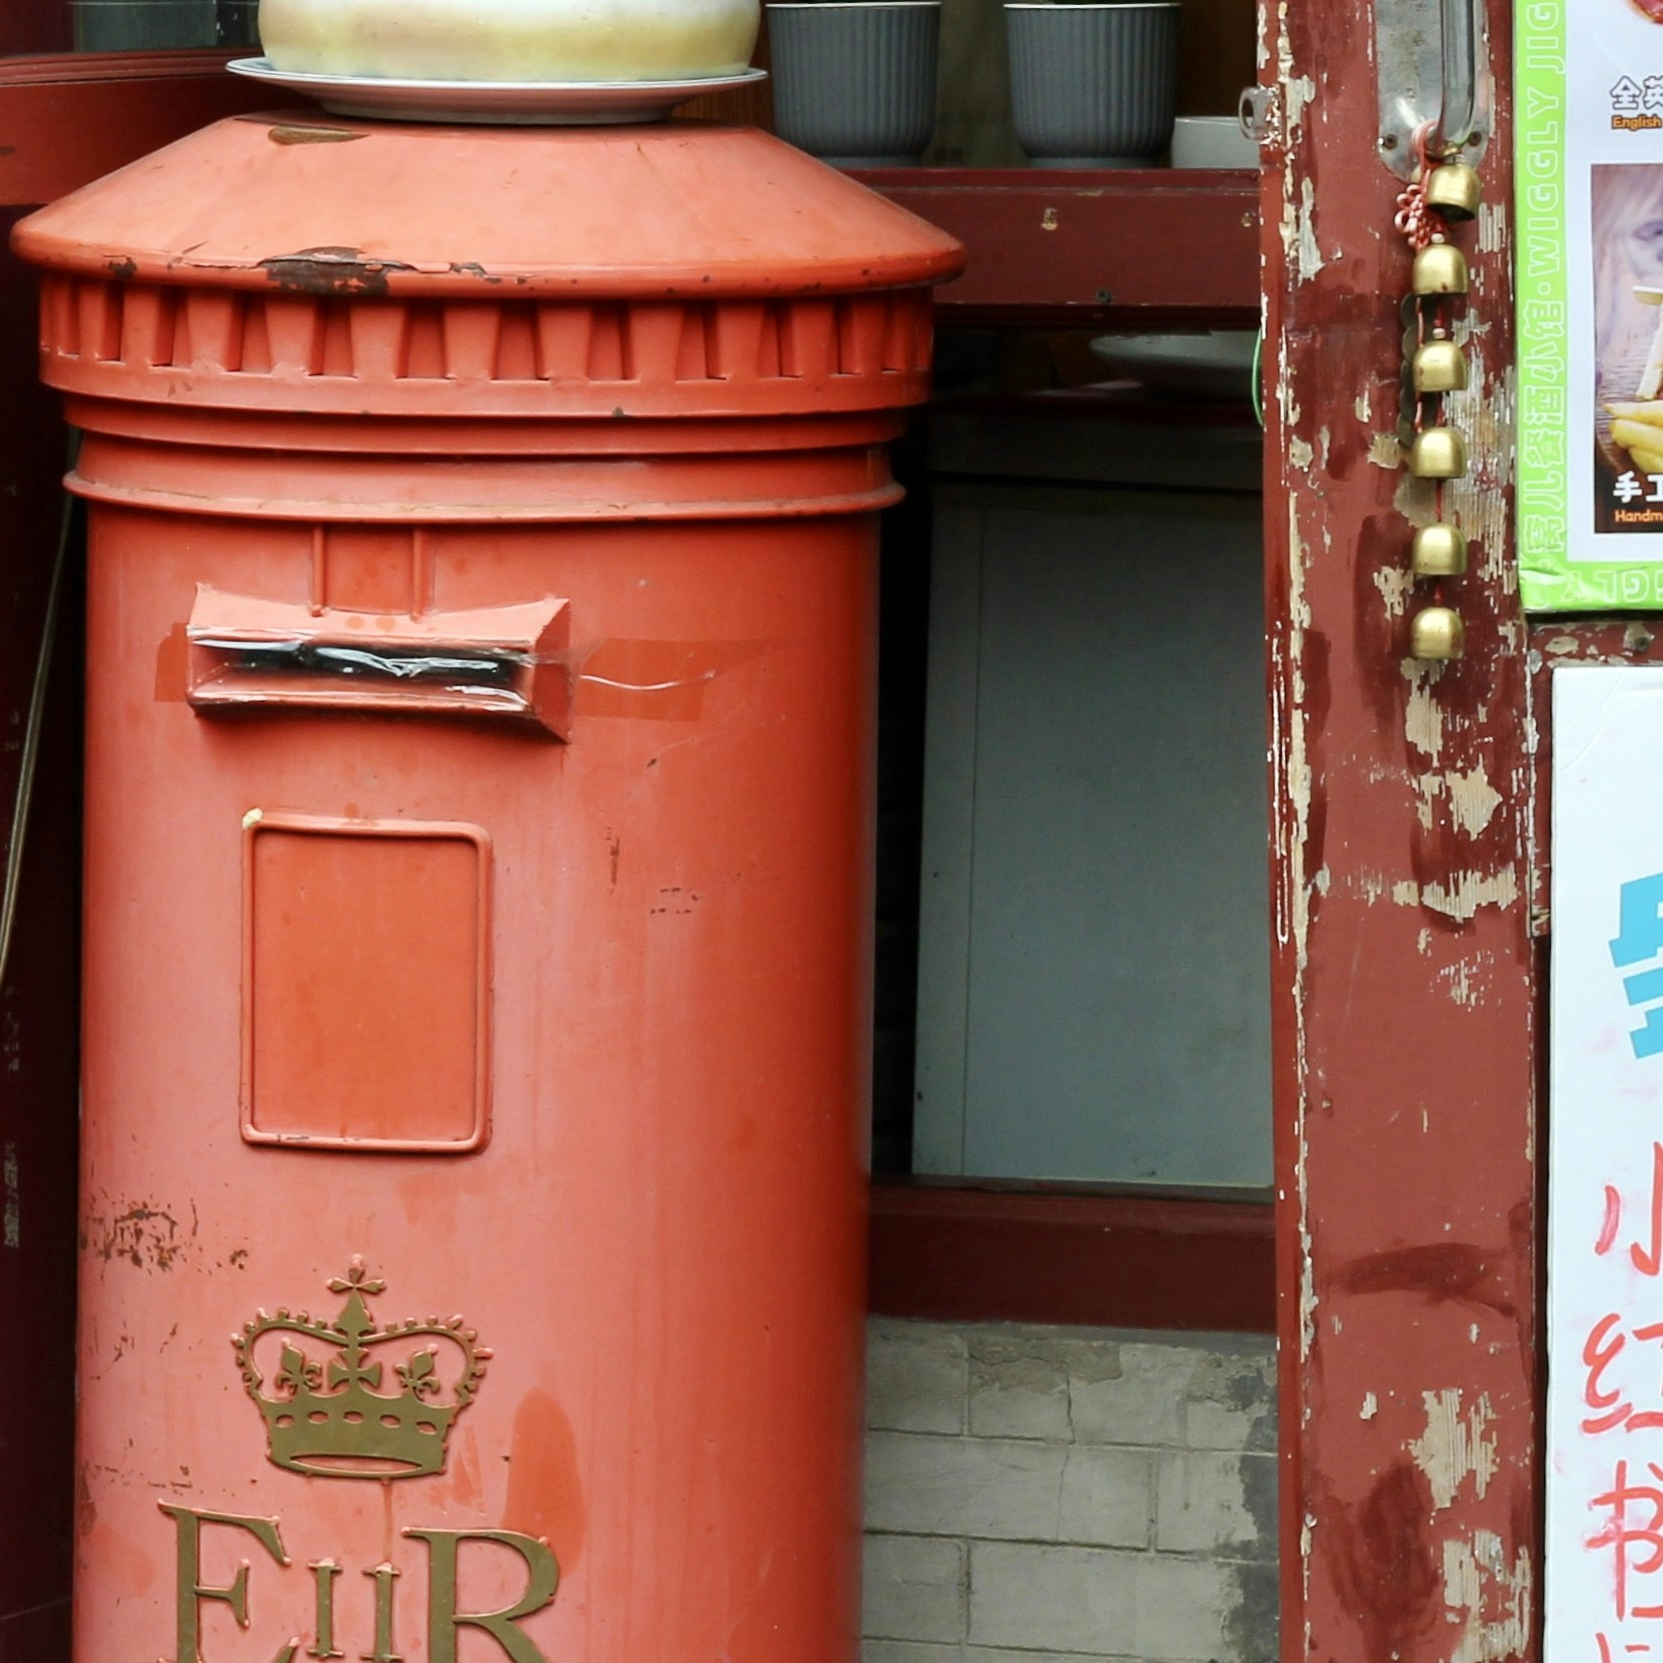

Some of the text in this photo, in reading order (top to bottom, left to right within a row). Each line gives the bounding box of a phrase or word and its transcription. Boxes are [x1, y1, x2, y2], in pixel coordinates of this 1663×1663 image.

[1611, 114, 1662, 131] English
[1614, 509, 1663, 522] Handm
[1560, 568, 1663, 604] GLY
